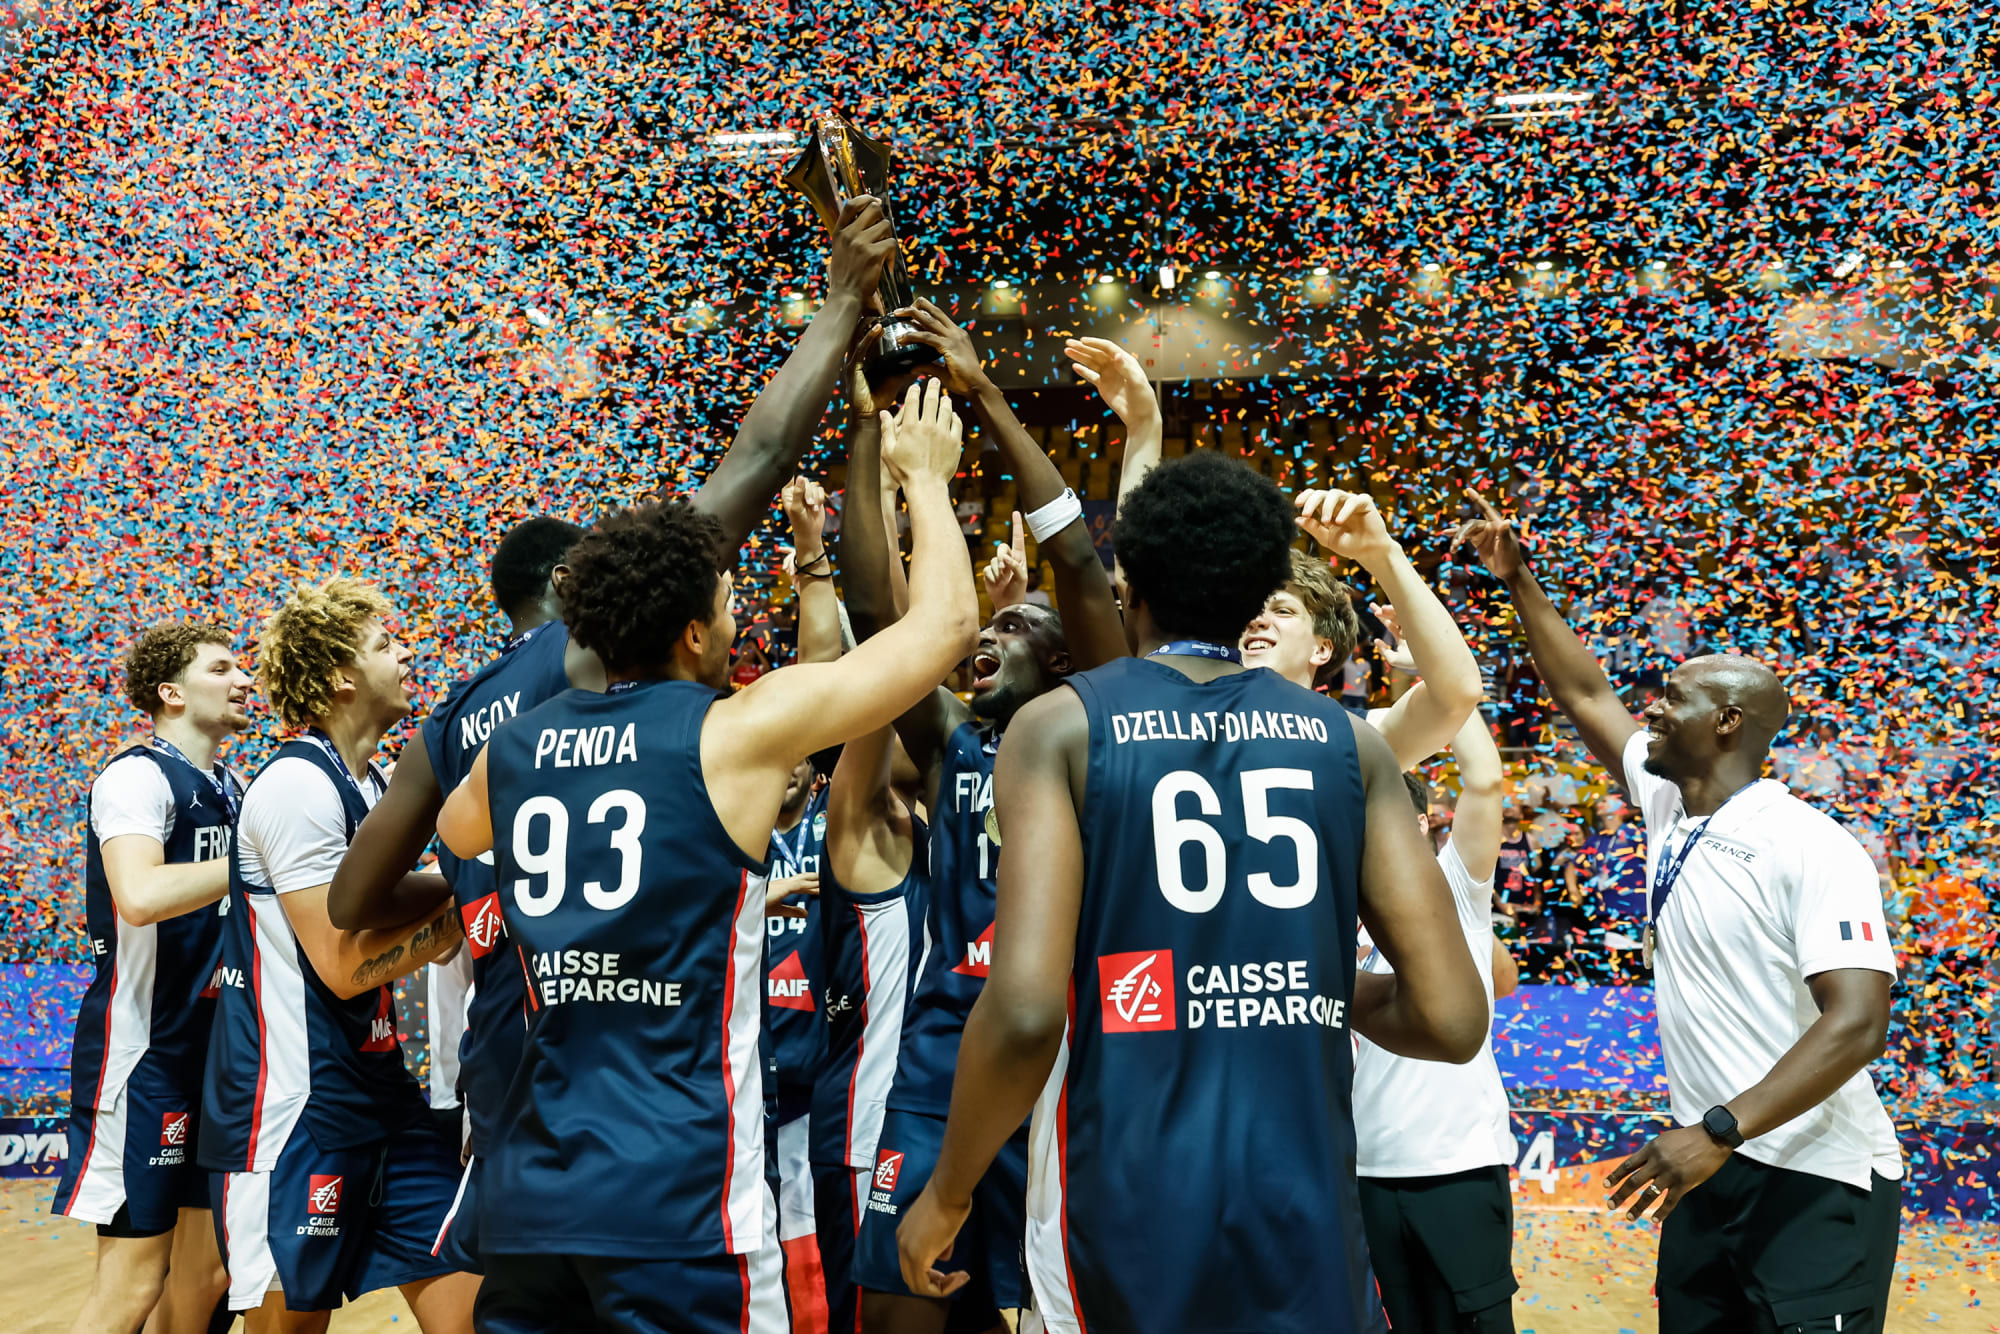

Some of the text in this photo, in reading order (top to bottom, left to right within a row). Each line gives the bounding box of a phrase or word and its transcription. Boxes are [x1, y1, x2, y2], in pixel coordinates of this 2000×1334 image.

[461, 690, 521, 751] NGOY
[1111, 709, 1328, 744] DZELLAT-DIAKENO
[534, 722, 638, 769] PENDA
[955, 771, 995, 814] FRA
[512, 789, 647, 917] 93
[1151, 767, 1319, 914] 65
[1702, 839, 1756, 864] FRANCE
[1186, 960, 1310, 995] CAISSE
[1187, 994, 1345, 1029] D'EPARGNE
[309, 1216, 336, 1226] CAISSE
